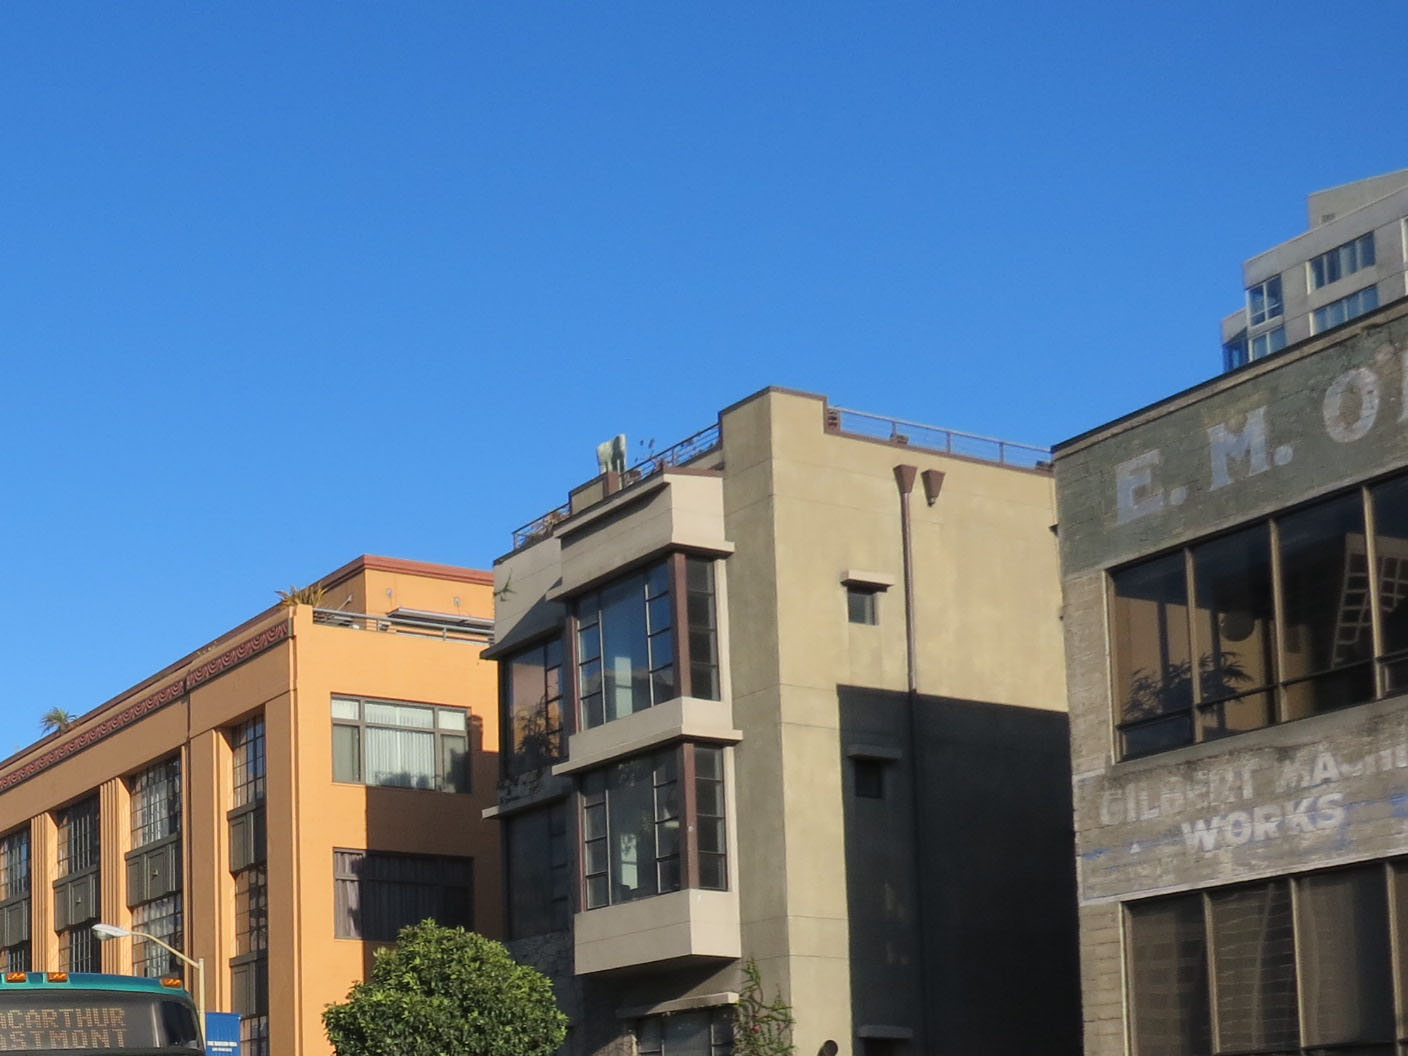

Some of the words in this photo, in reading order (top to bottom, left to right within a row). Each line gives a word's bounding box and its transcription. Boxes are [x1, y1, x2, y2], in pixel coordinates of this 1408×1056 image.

[1115, 449, 1188, 526] E.
[1208, 404, 1293, 492] M.
[1181, 793, 1344, 853] WORKS
